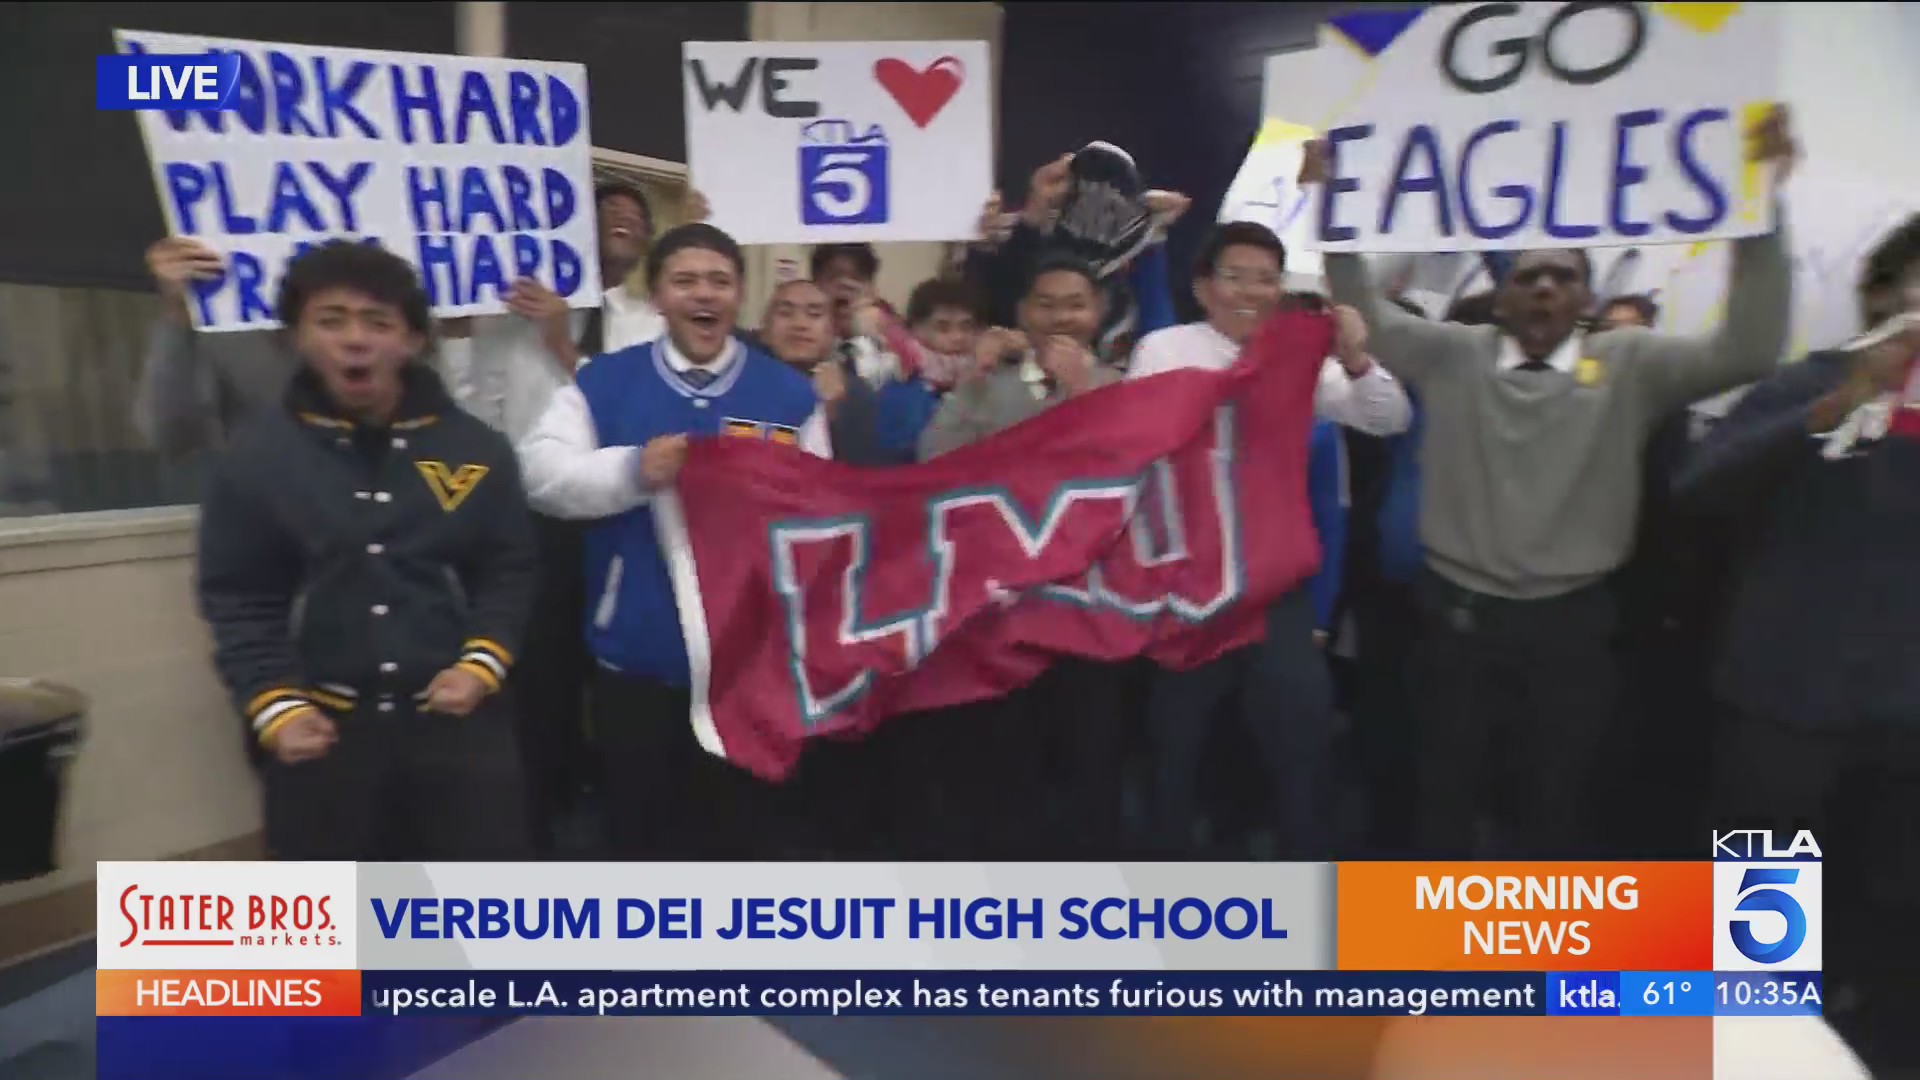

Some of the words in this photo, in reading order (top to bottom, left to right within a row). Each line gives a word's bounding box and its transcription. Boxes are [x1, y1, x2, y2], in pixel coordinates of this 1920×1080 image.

[690, 57, 820, 118] WE
[1440, 1, 1646, 92] GO
[127, 40, 382, 140] ORK
[390, 65, 580, 146] HARD
[163, 161, 373, 235] PLAY
[407, 166, 575, 233] HARD
[811, 152, 872, 217] 5
[769, 400, 1246, 724] LMU
